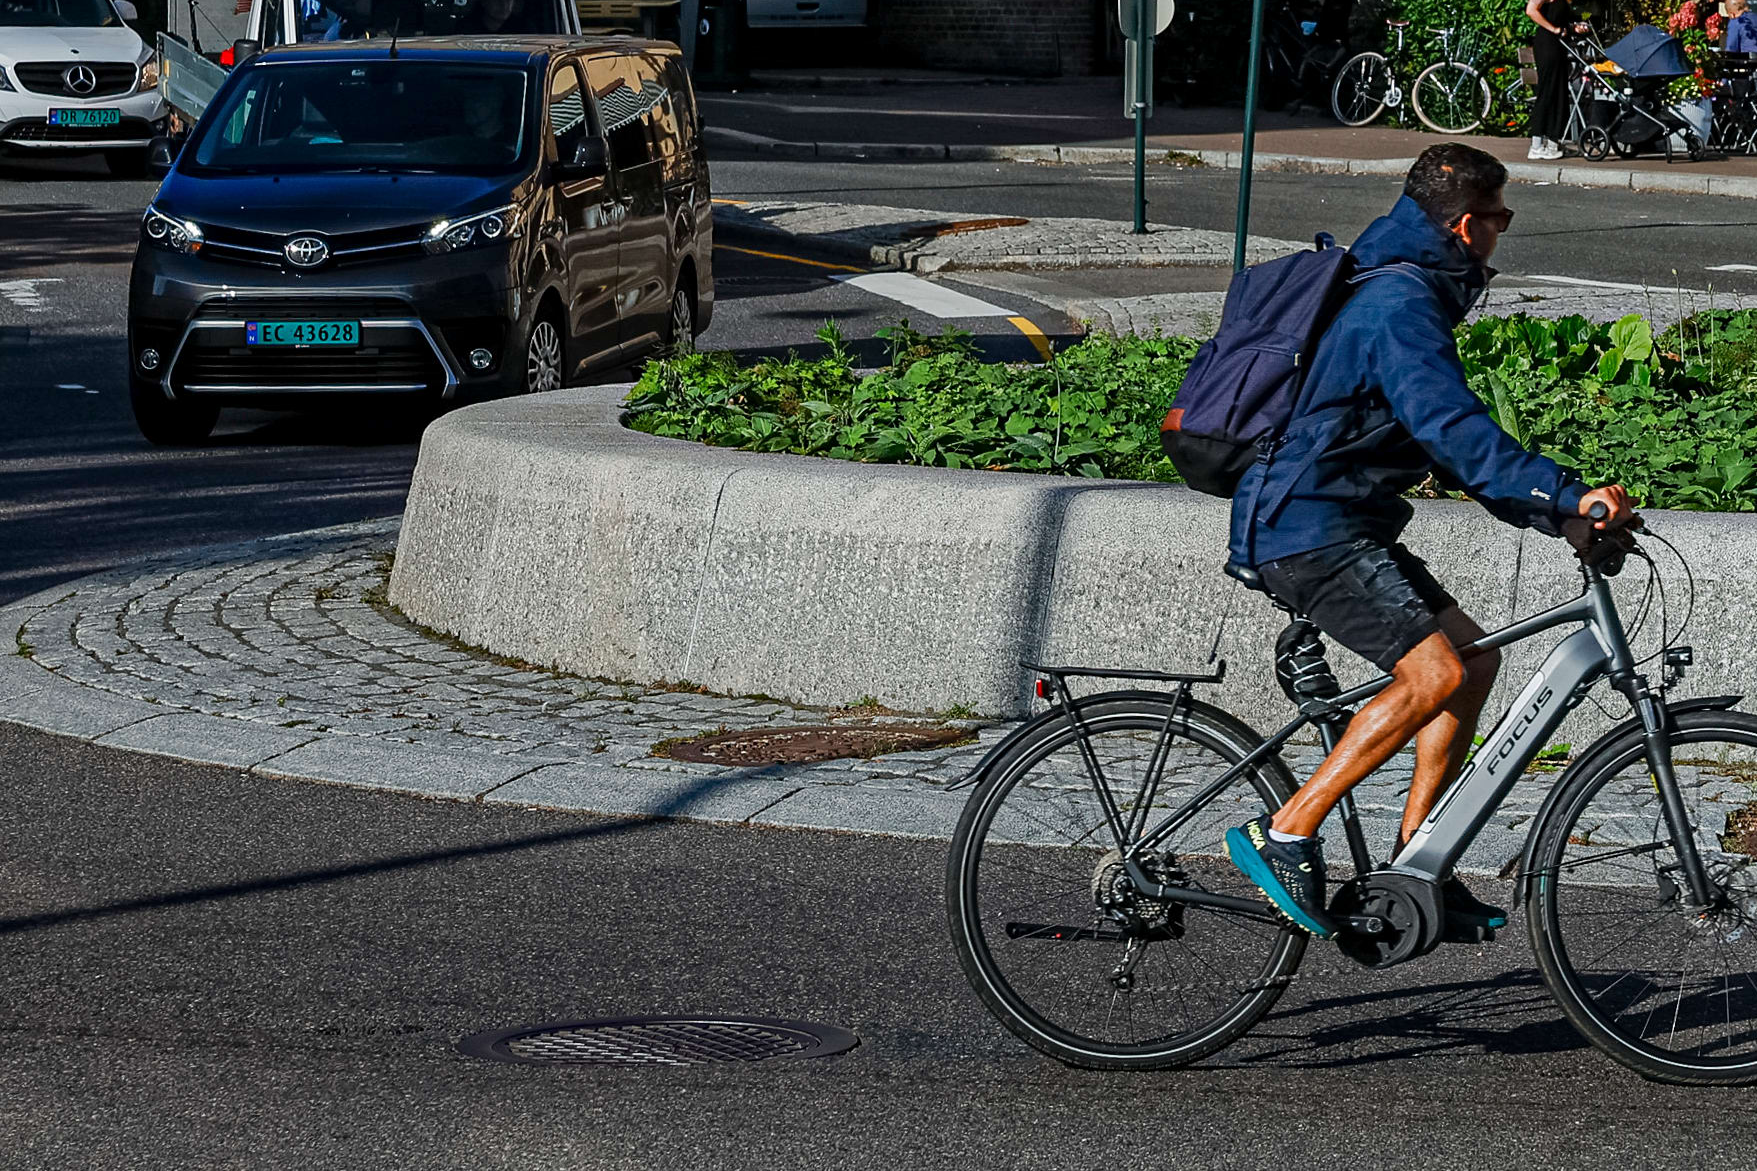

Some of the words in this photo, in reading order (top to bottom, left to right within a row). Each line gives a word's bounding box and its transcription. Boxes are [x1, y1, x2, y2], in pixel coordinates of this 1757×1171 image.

[60, 110, 77, 124] DR
[82, 110, 117, 124] 76120
[261, 324, 289, 343] EC
[293, 324, 354, 343] 43628
[1486, 685, 1554, 777] FOCUS
[1246, 820, 1267, 851] HOKA
